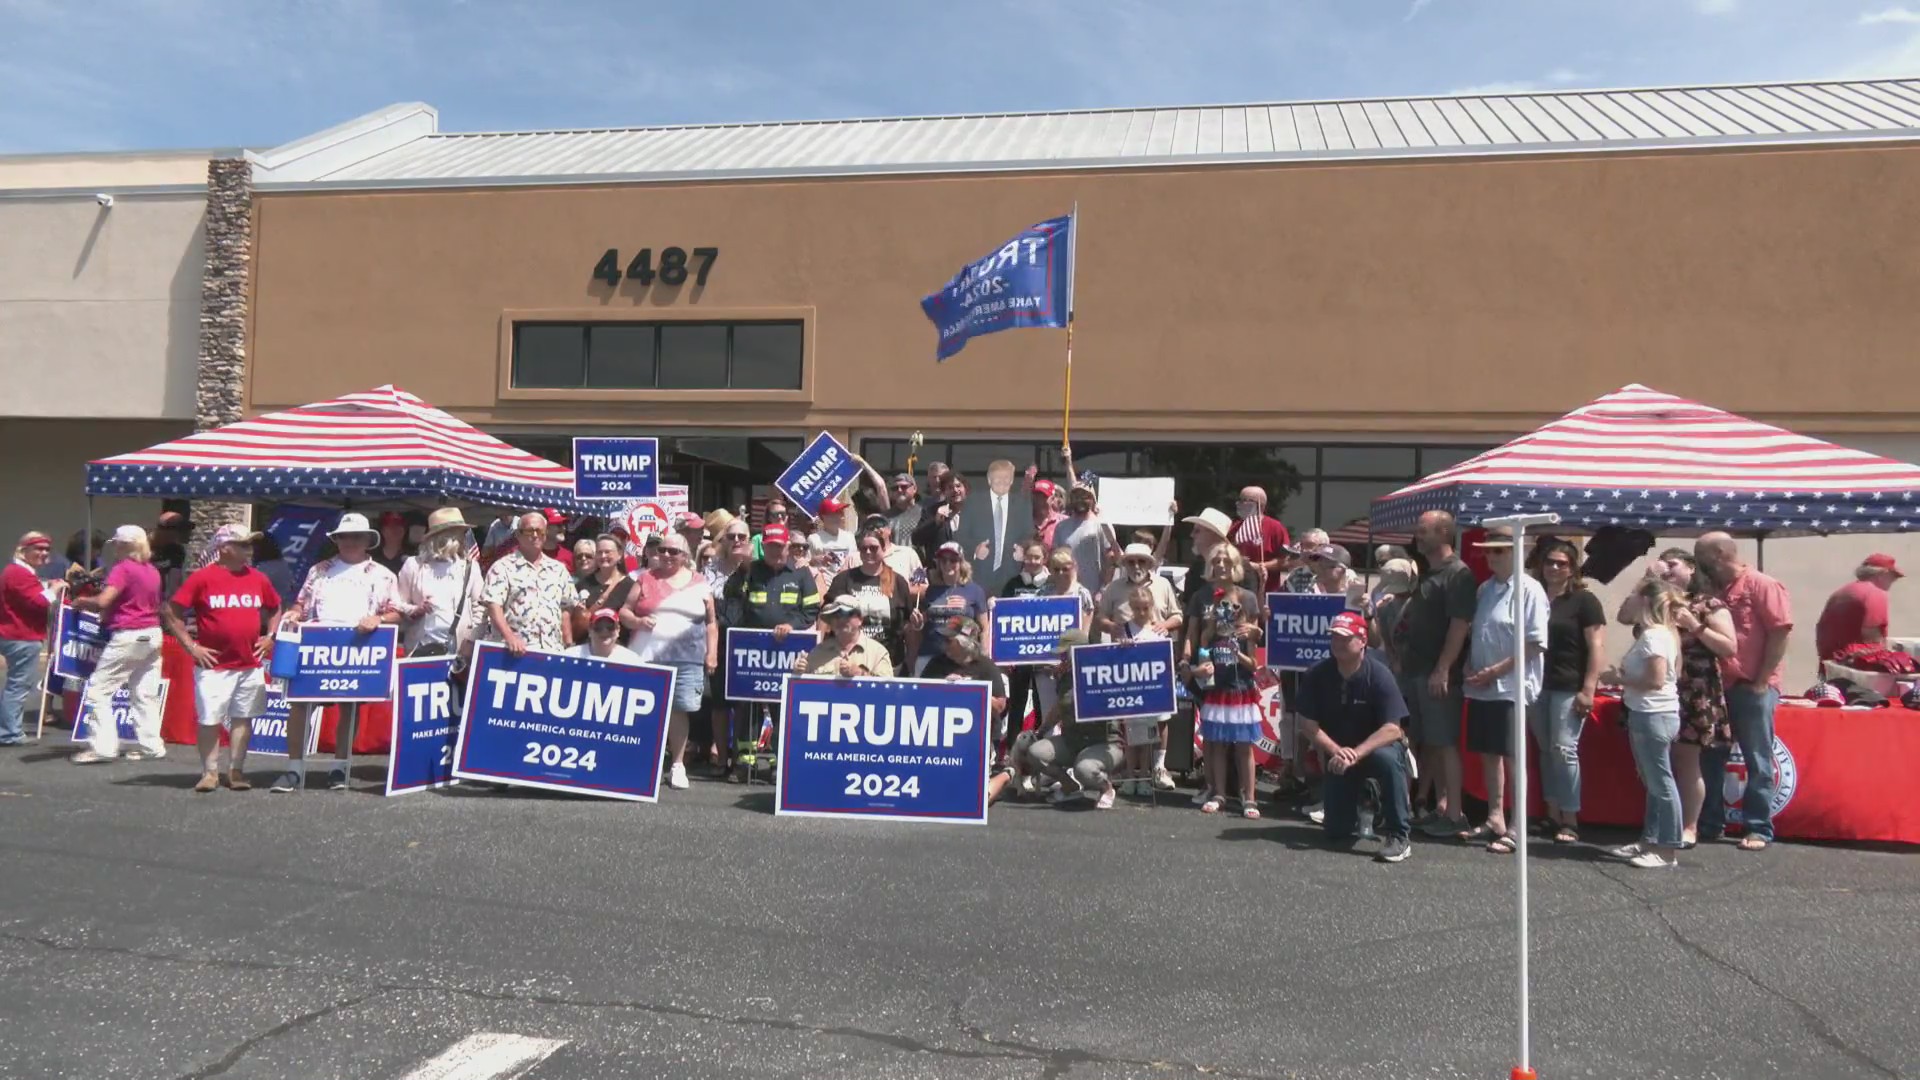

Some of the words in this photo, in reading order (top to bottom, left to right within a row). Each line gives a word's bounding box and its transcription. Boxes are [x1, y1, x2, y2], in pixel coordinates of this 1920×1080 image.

[593, 246, 719, 286] 4487
[580, 455, 651, 471] TRUMP
[790, 446, 838, 496] TRUMP
[601, 481, 632, 491] 2024
[820, 475, 842, 497] 2024
[209, 594, 262, 609] MAGA
[997, 614, 1074, 634] TRUMP
[1273, 613, 1335, 636] TRUM
[299, 645, 387, 667] TRUMP
[734, 648, 800, 669] TRUM
[1018, 643, 1052, 655] 2024
[1296, 647, 1331, 660] 2024
[1081, 661, 1166, 686] TRUMP
[319, 679, 359, 691] 2024
[407, 682, 463, 722] TRU
[487, 668, 655, 726] TRUMP
[1107, 695, 1144, 709] 2024
[412, 729, 433, 740] MAKE
[488, 717, 516, 729] MAKE
[518, 721, 566, 736] AMERICA
[568, 728, 602, 740] GREAT
[604, 732, 641, 745] AGAIN!
[799, 701, 974, 747] TRUMP
[522, 741, 597, 771] 2024
[804, 751, 834, 761] MAKE
[836, 752, 885, 763] AMERICA
[887, 754, 923, 765] GREAT
[925, 756, 963, 766] AGAIN!
[844, 773, 921, 798] 2024
